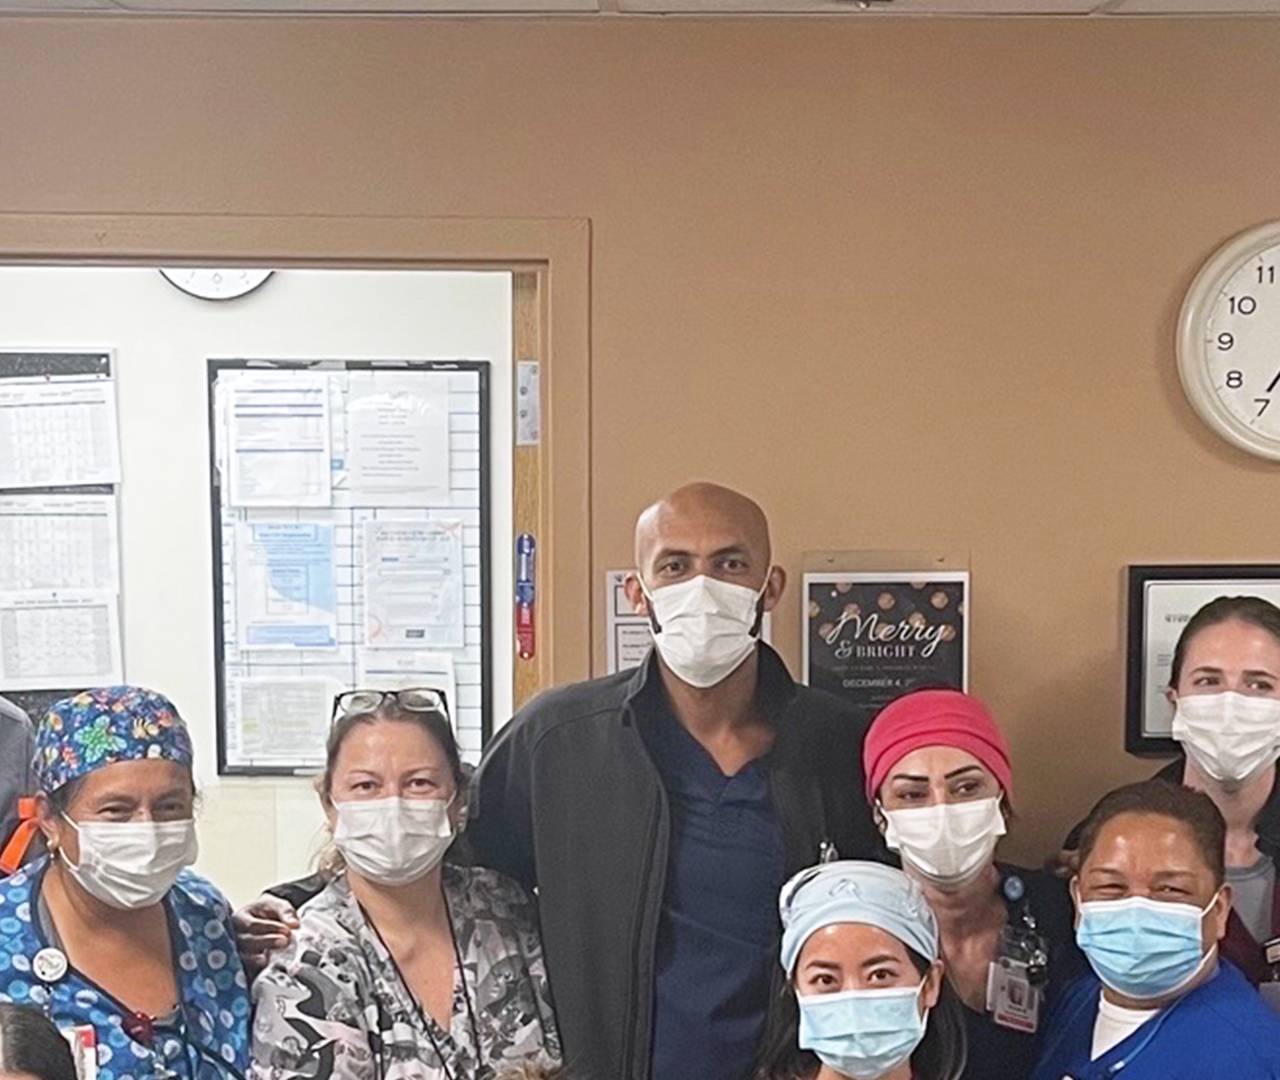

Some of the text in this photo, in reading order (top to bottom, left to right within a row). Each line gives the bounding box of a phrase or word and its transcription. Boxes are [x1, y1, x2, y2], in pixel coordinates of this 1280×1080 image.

[1257, 266, 1275, 284] 11
[1228, 296, 1257, 315] 10
[1217, 332, 1234, 351] 9
[1226, 370, 1243, 388] 8
[1254, 398, 1270, 417] 7
[826, 611, 946, 658] Merry
[855, 645, 917, 658] BRIGHT
